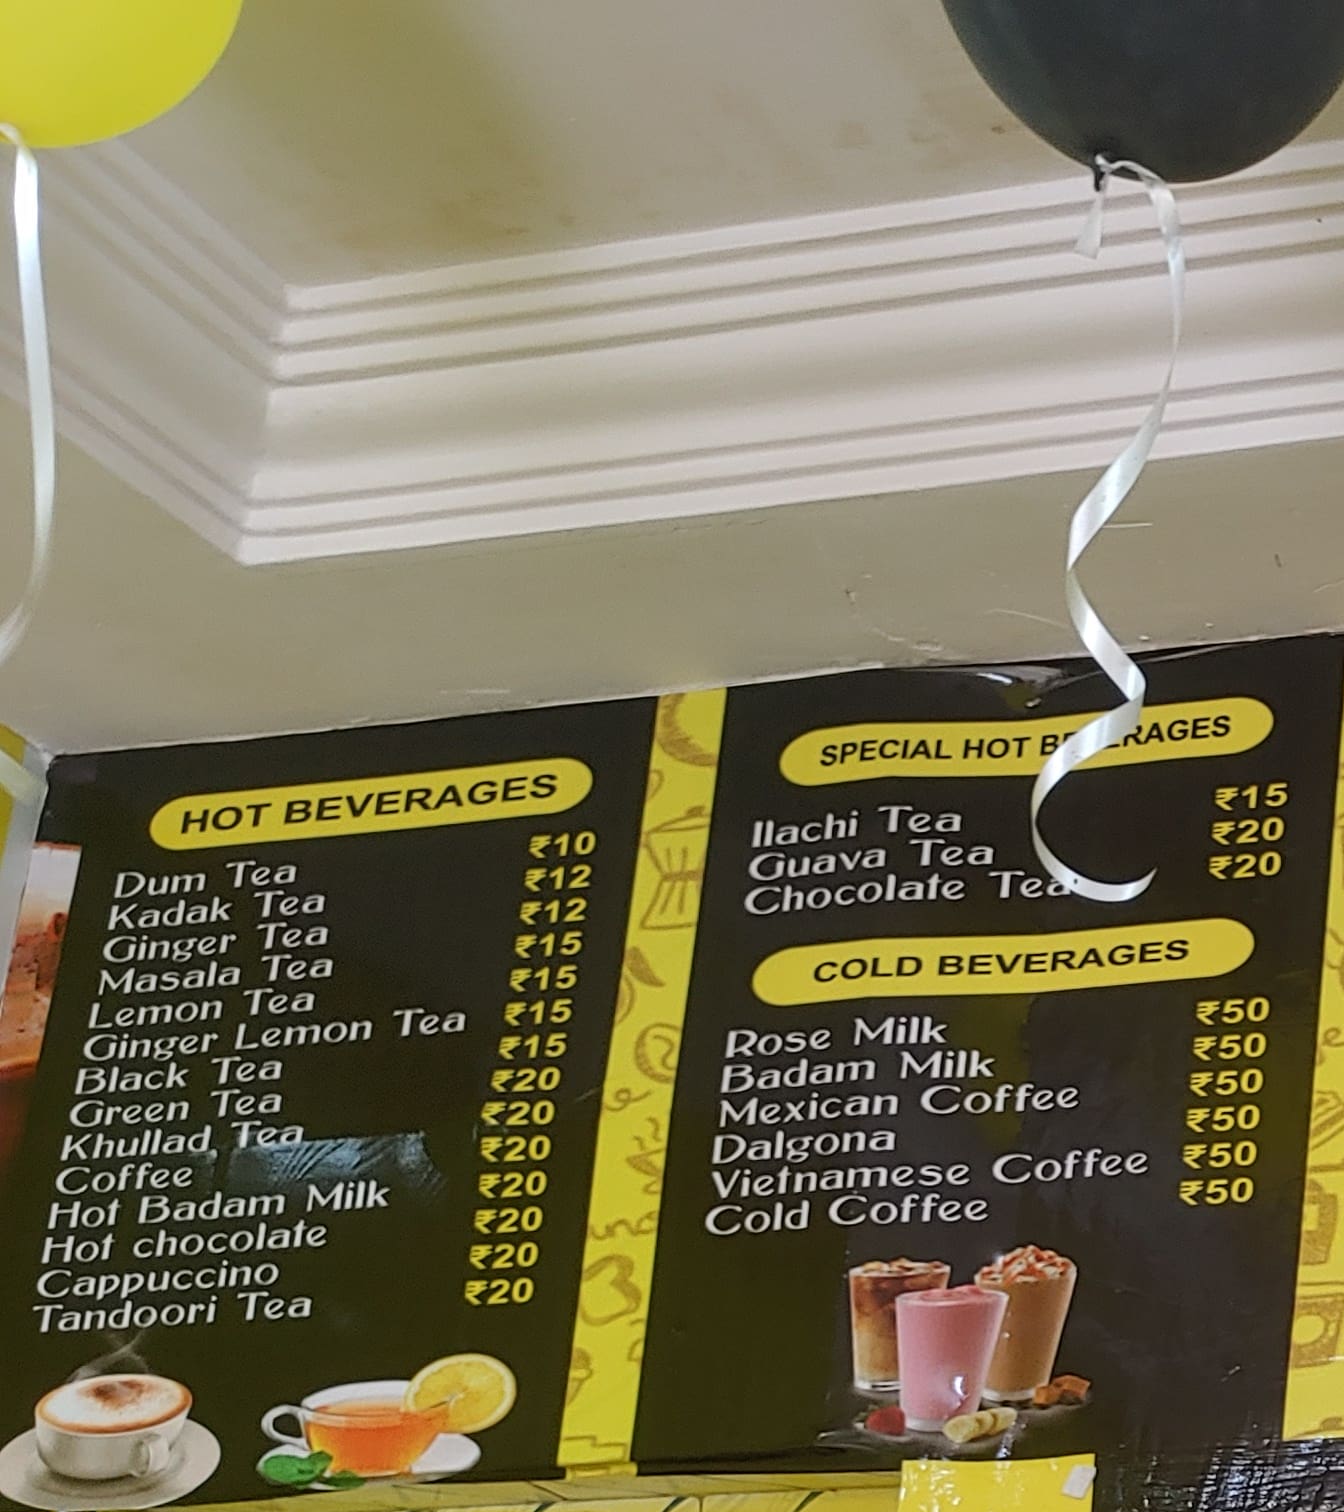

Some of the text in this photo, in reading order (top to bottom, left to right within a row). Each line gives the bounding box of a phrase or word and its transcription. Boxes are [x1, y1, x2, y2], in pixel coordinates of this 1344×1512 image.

[181, 775, 556, 833] HOT BEVERAGES
[752, 806, 961, 847] Ilachi Tea
[115, 832, 595, 898] Dum Tea ₹10
[749, 839, 993, 880] Guava Tea
[108, 865, 591, 930] Kadak Tea ₹12
[103, 923, 328, 962] Ginger Tea
[814, 940, 1188, 982] COLD BEVERAGES
[99, 954, 332, 995] Masala Tea
[89, 988, 314, 1028] Lemon Tea
[726, 998, 1269, 1058] Rose Milk ₹50
[84, 1009, 465, 1060] Ginger Lemon Tea
[75, 1033, 566, 1094] Black Tea ₹15
[721, 1050, 994, 1093] Badam Milk
[70, 1089, 281, 1127] Green Tea
[720, 1084, 1078, 1127] Mexican Coffee
[61, 1121, 304, 1160] Khullad Tea
[713, 1131, 895, 1163] Dalgona
[56, 1163, 192, 1194] Coffee
[712, 1149, 1147, 1198] Vietnamese Coffee
[48, 1180, 389, 1229] Hot Badam Milk
[706, 1194, 987, 1234] Cold Coffee
[42, 1220, 326, 1263] Hot chocolate
[37, 1242, 538, 1300] Cappuccino ₹20
[33, 1292, 311, 1332] Tandoori Tea
